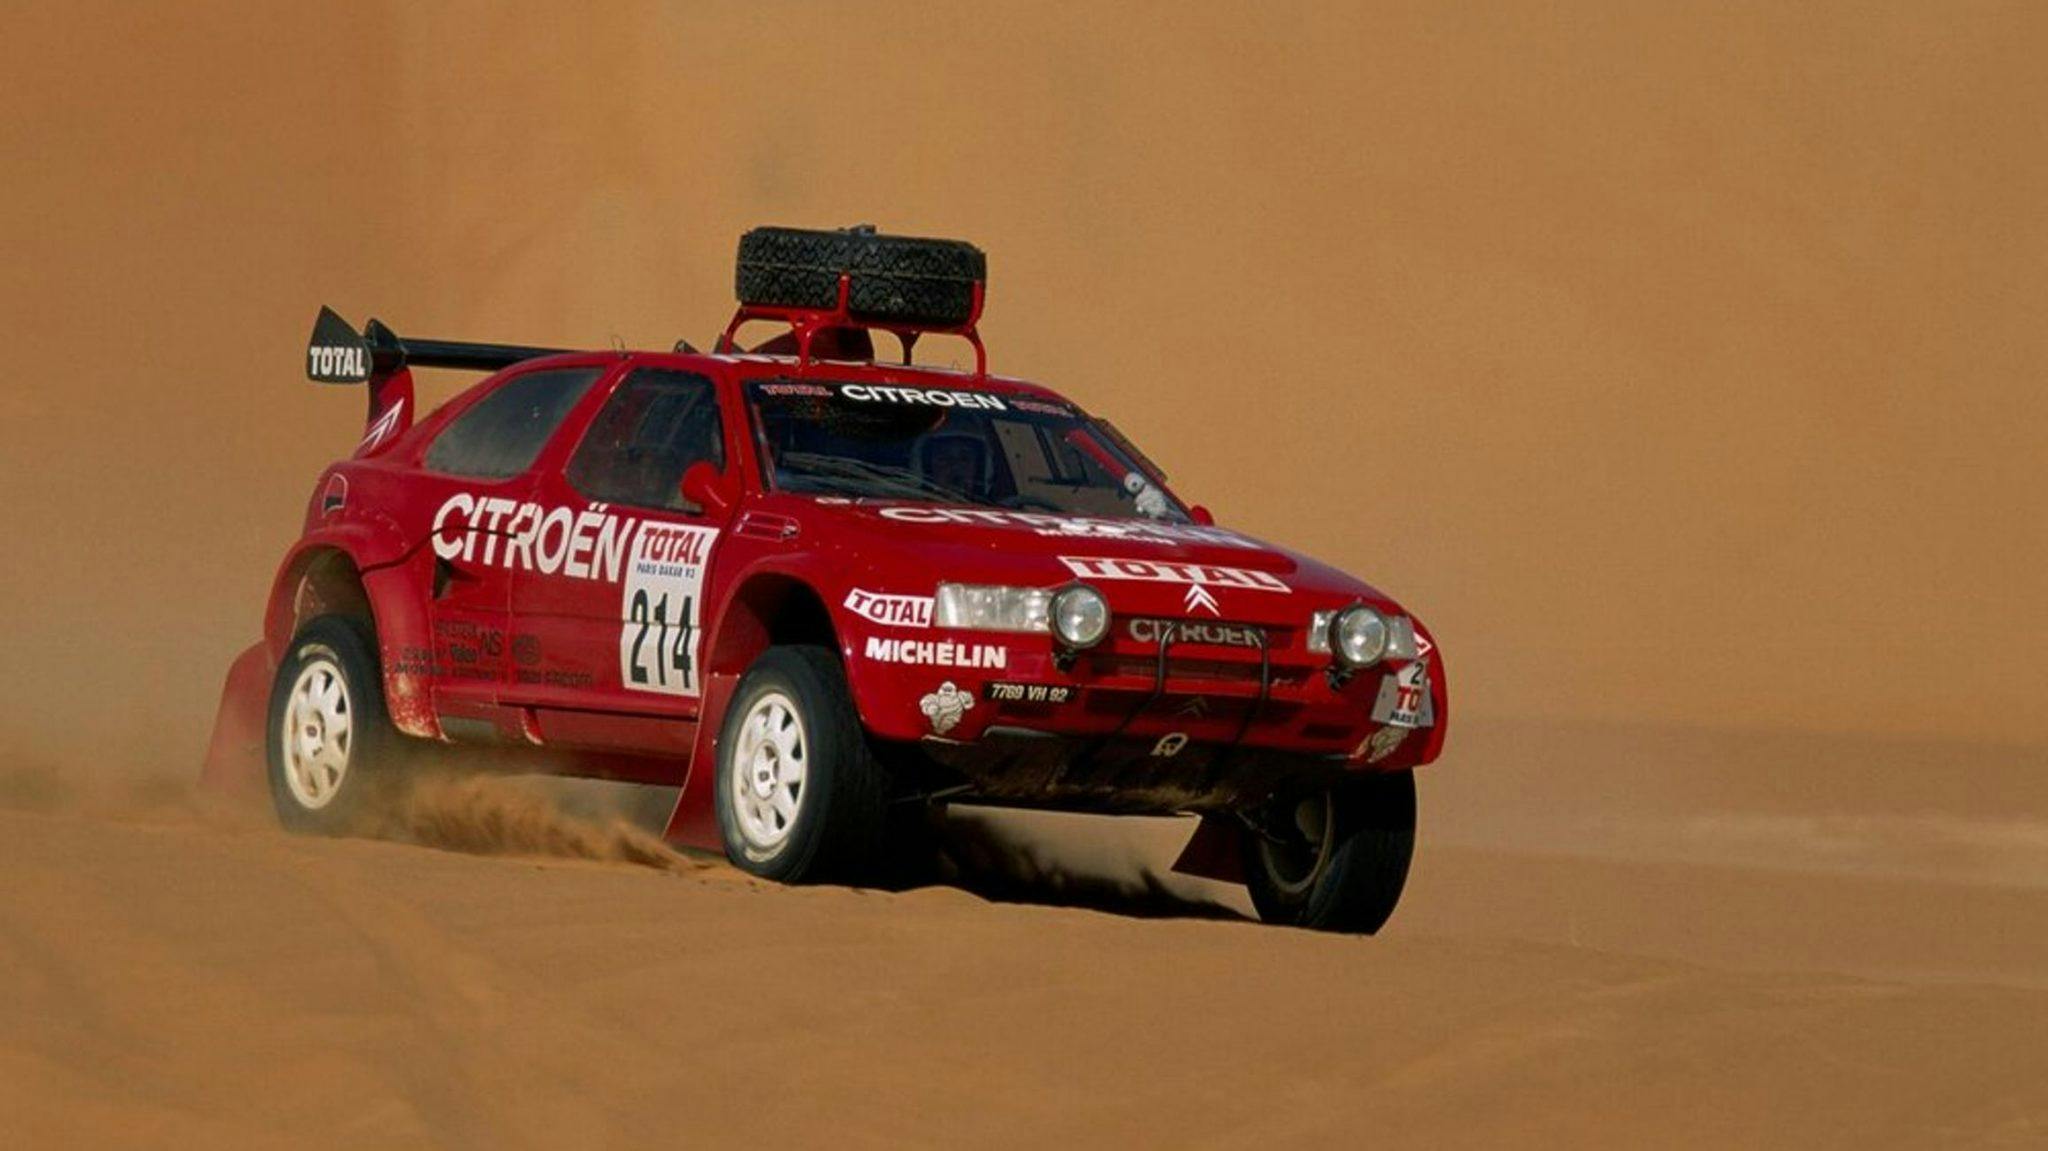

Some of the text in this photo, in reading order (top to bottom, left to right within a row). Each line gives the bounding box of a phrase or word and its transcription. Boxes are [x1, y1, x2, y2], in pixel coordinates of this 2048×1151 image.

[310, 346, 365, 376] TOTAL
[841, 383, 1007, 411] CITROEN
[432, 493, 636, 583] CITROËN
[639, 527, 705, 565] TOTAL
[1066, 557, 1284, 589] TOTAL
[853, 592, 927, 625] TOTAL
[628, 588, 693, 689] 214
[865, 636, 1006, 669] MICHELIN
[1410, 662, 1424, 685] 2
[1028, 684, 1048, 701] VH
